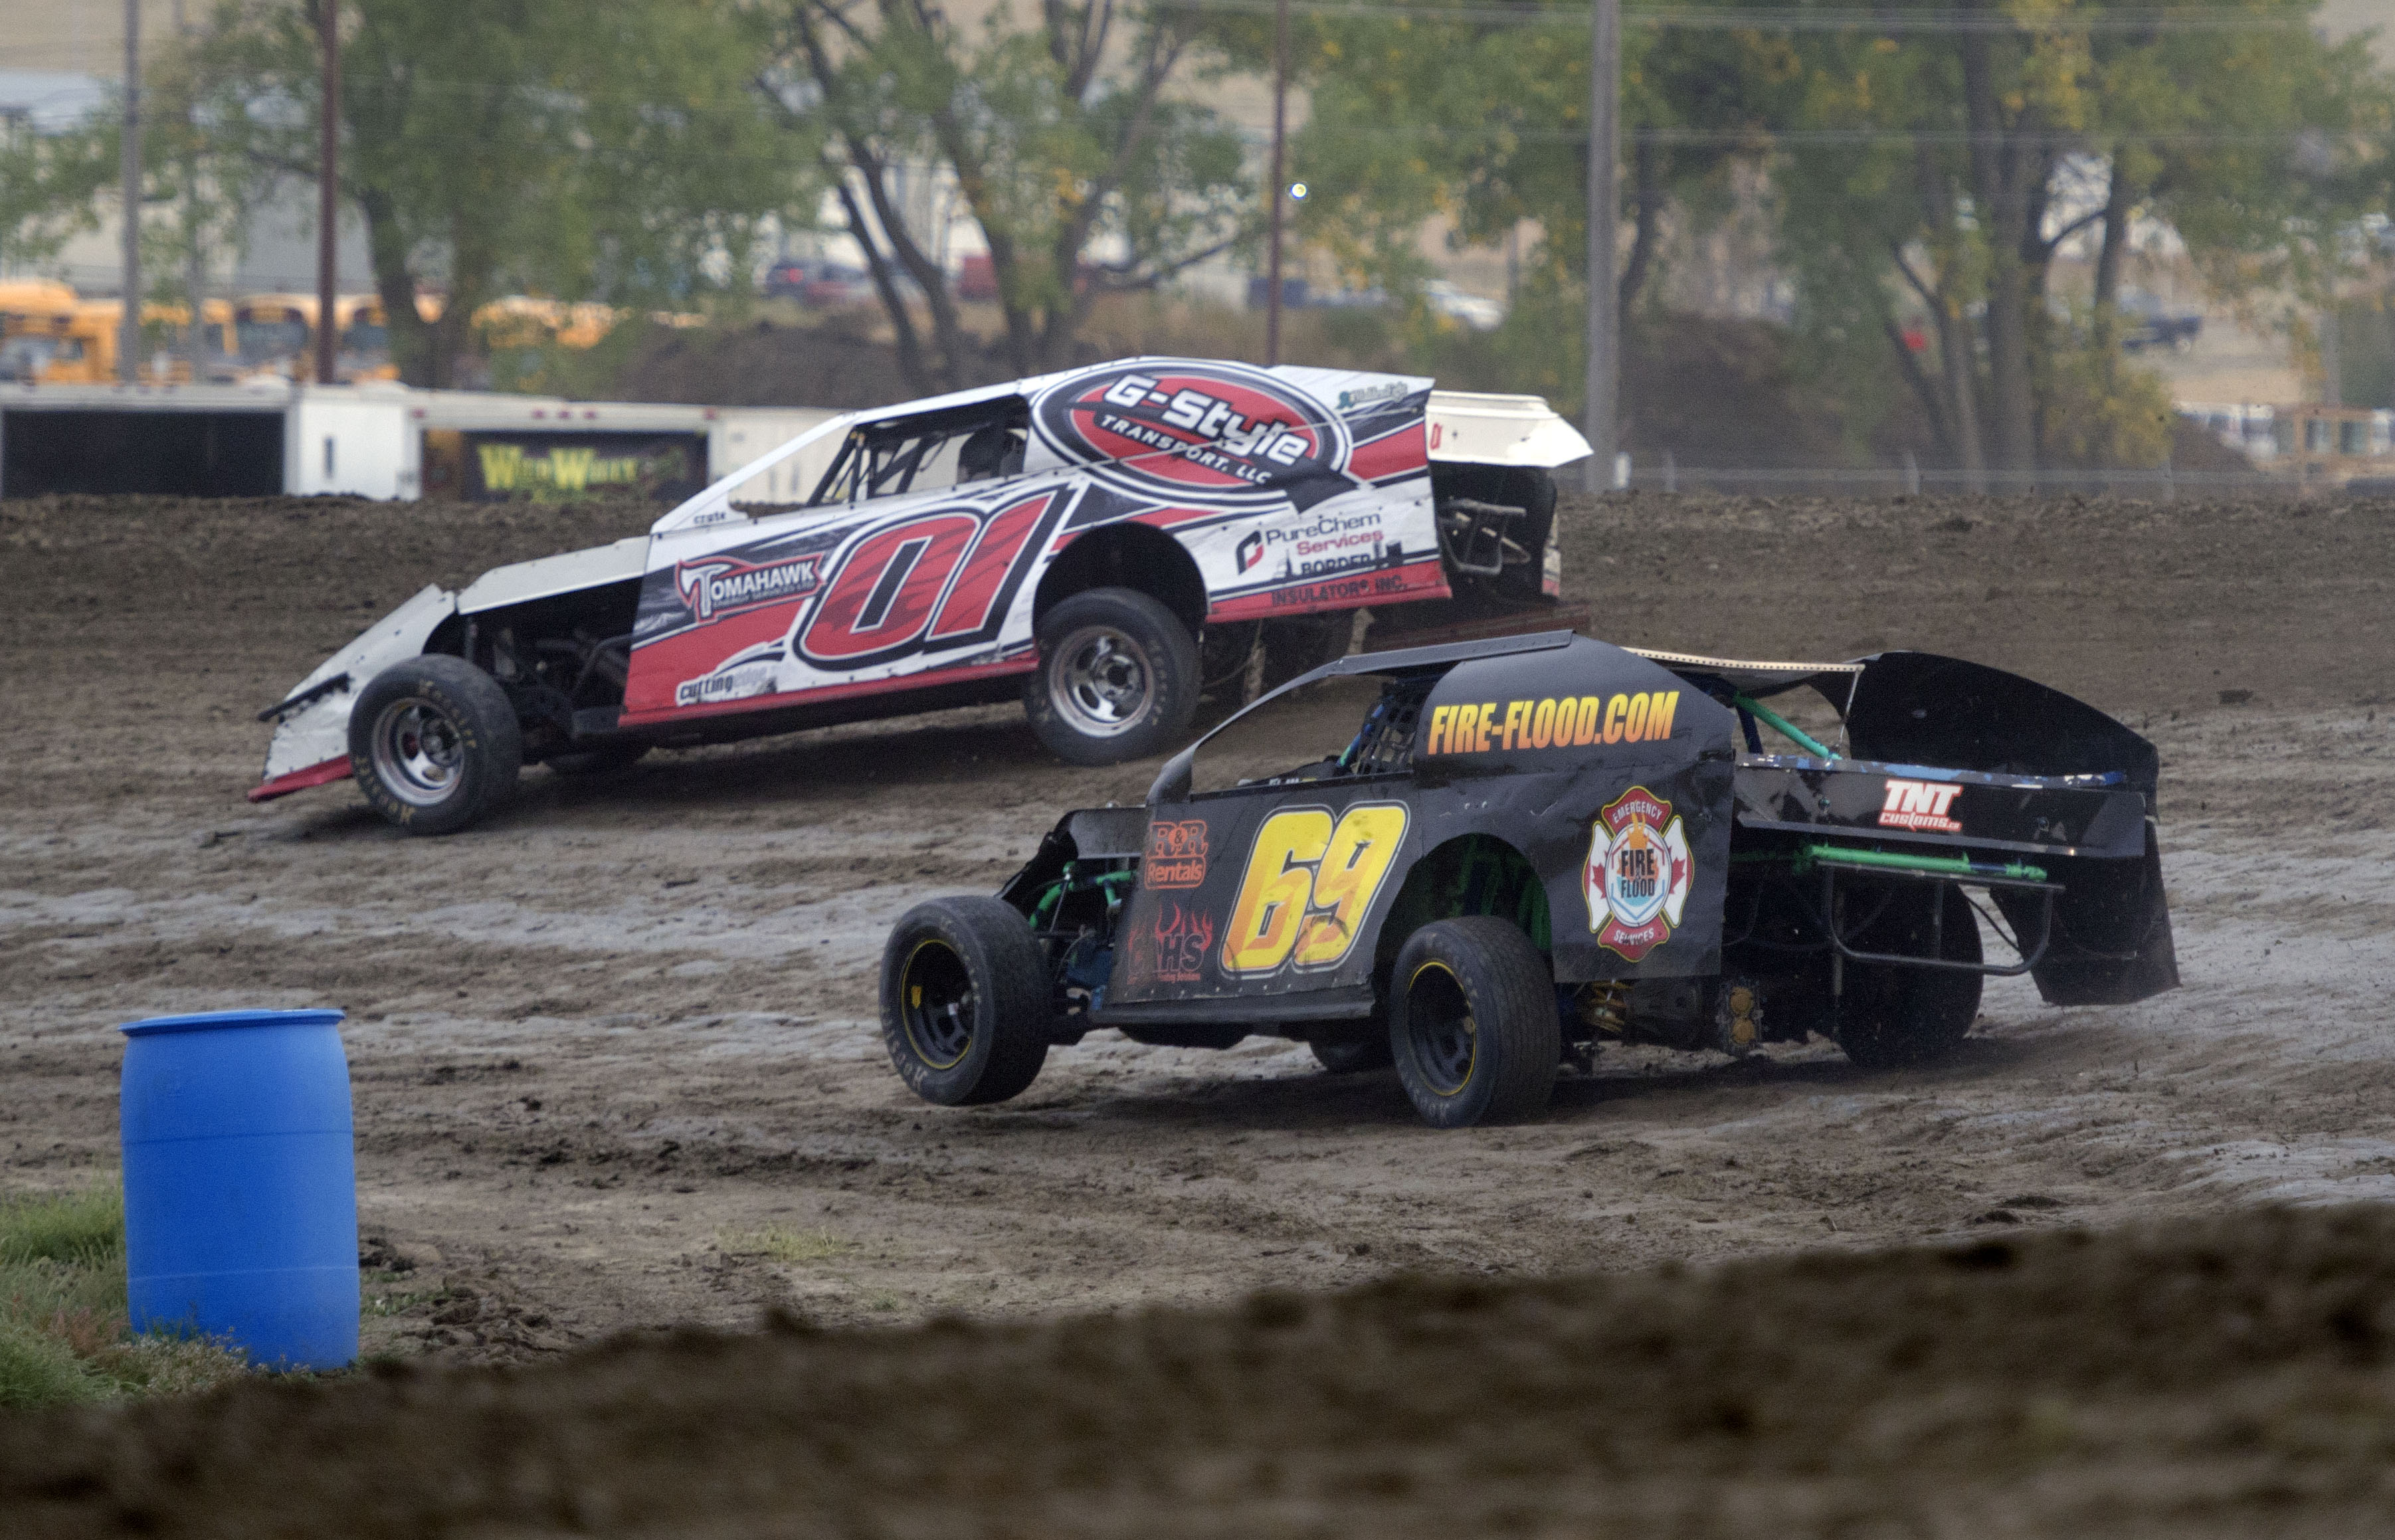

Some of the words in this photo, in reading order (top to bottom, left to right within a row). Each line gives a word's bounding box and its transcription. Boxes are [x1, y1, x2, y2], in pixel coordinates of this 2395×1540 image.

[1103, 374, 1309, 466] G-Style
[1236, 464, 1272, 484] LLC
[1266, 512, 1381, 545] PureChem
[1297, 529, 1384, 556] Services
[799, 492, 1055, 661] 01
[680, 675, 733, 700] cutting
[1428, 691, 1679, 755] FIRE-FLOOD.COM
[1884, 780, 1961, 815] TNT
[1612, 801, 1662, 824] EMERGENCY
[1148, 860, 1203, 882] Rentals
[1621, 848, 1655, 877] FIRE
[1220, 802, 1408, 977] 69
[1621, 878, 1656, 898] FLOOD
